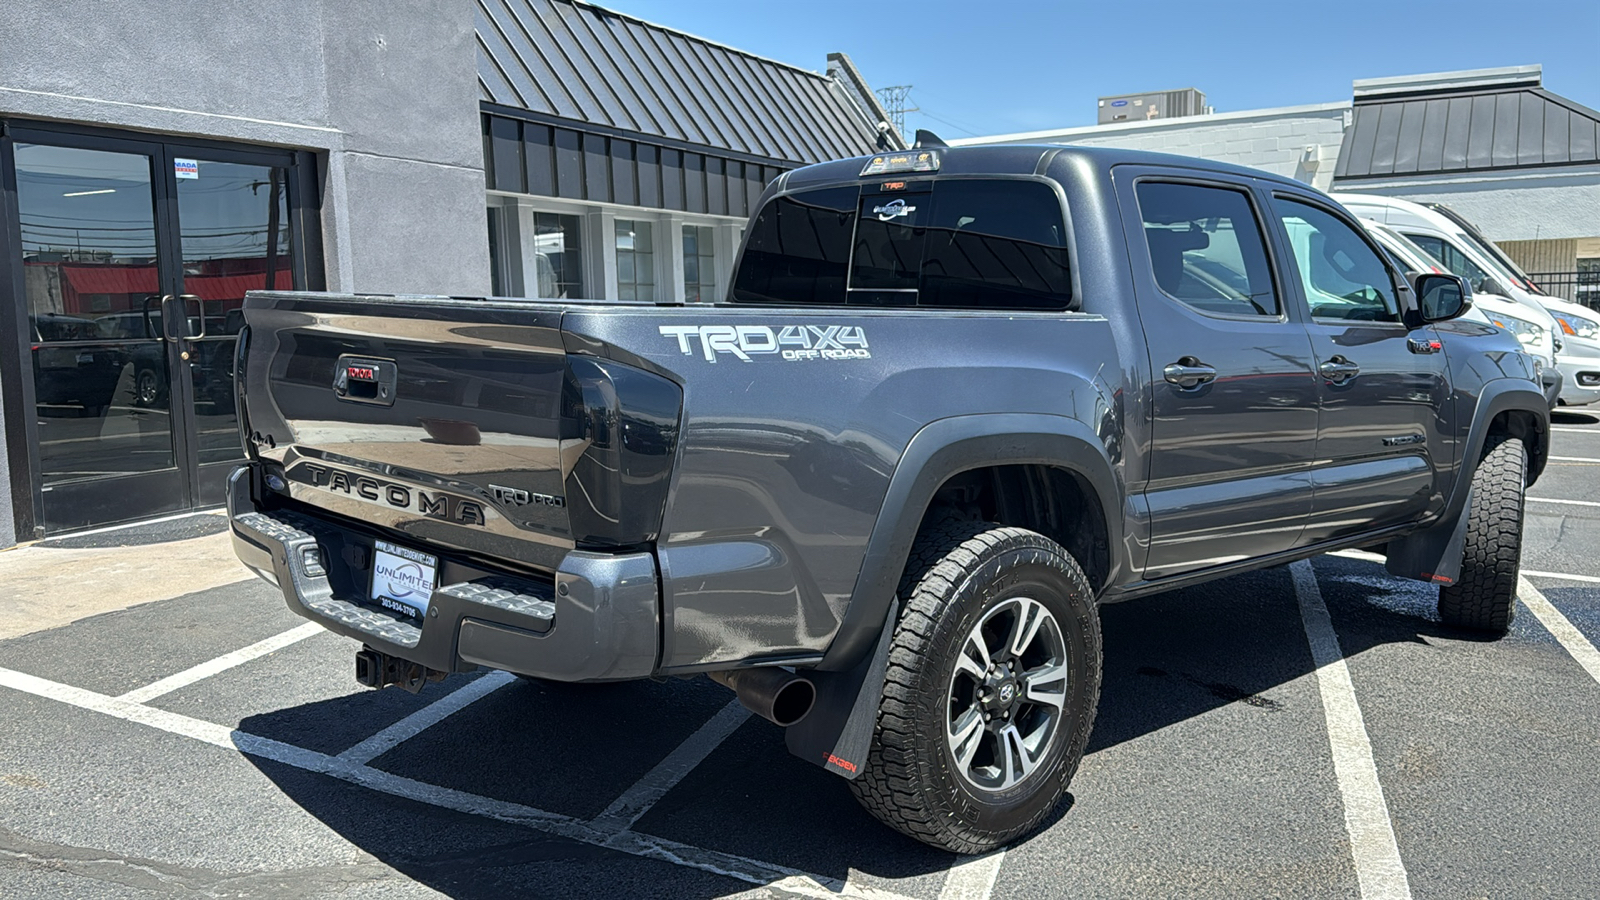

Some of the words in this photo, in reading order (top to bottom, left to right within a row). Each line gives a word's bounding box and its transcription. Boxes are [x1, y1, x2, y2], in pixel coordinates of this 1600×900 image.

[884, 182, 904, 190] TRD
[659, 325, 780, 363] TRD
[782, 350, 817, 361] OFF
[820, 348, 871, 361] ROAD
[348, 367, 374, 380] TOYOTA
[305, 463, 486, 526] TACOMA
[488, 484, 530, 507] TRD
[532, 492, 566, 508] PRO
